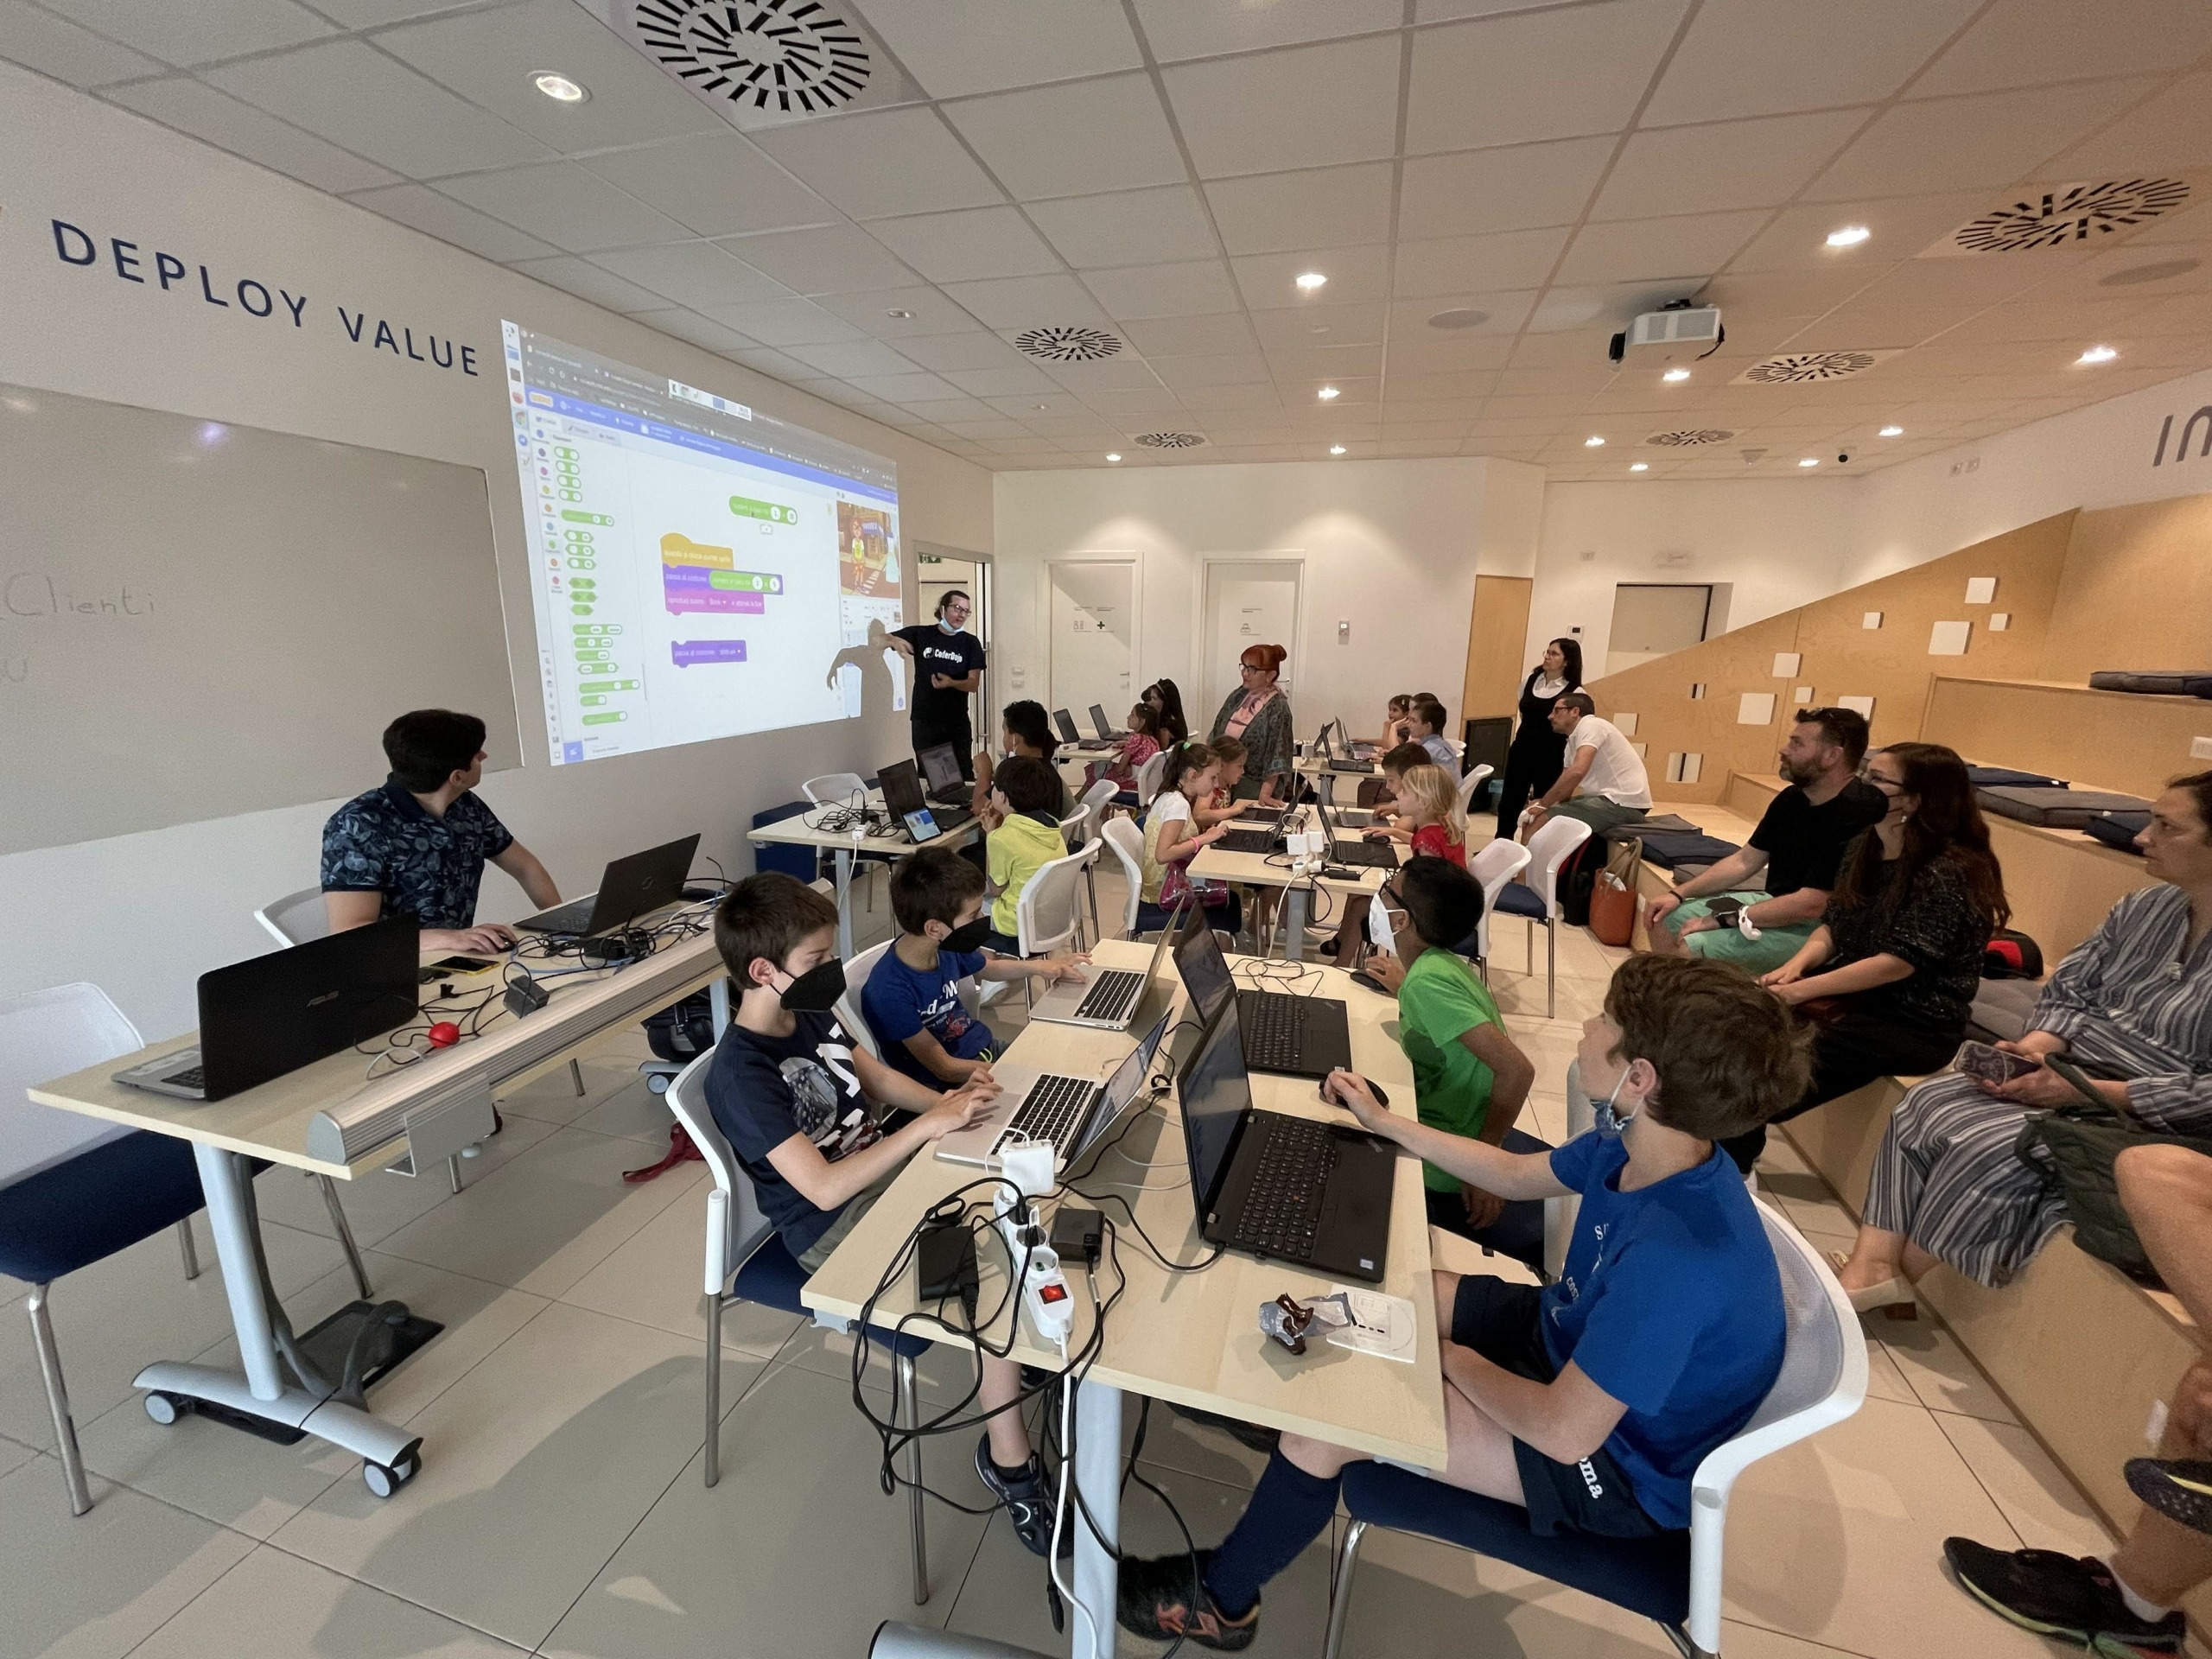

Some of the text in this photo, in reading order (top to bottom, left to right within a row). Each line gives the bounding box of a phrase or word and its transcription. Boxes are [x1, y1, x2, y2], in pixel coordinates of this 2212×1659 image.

[51, 219, 480, 377] DEPLOY VALUE
[4, 572, 156, 617] Clienti
[934, 648, 963, 664] CoderDojo
